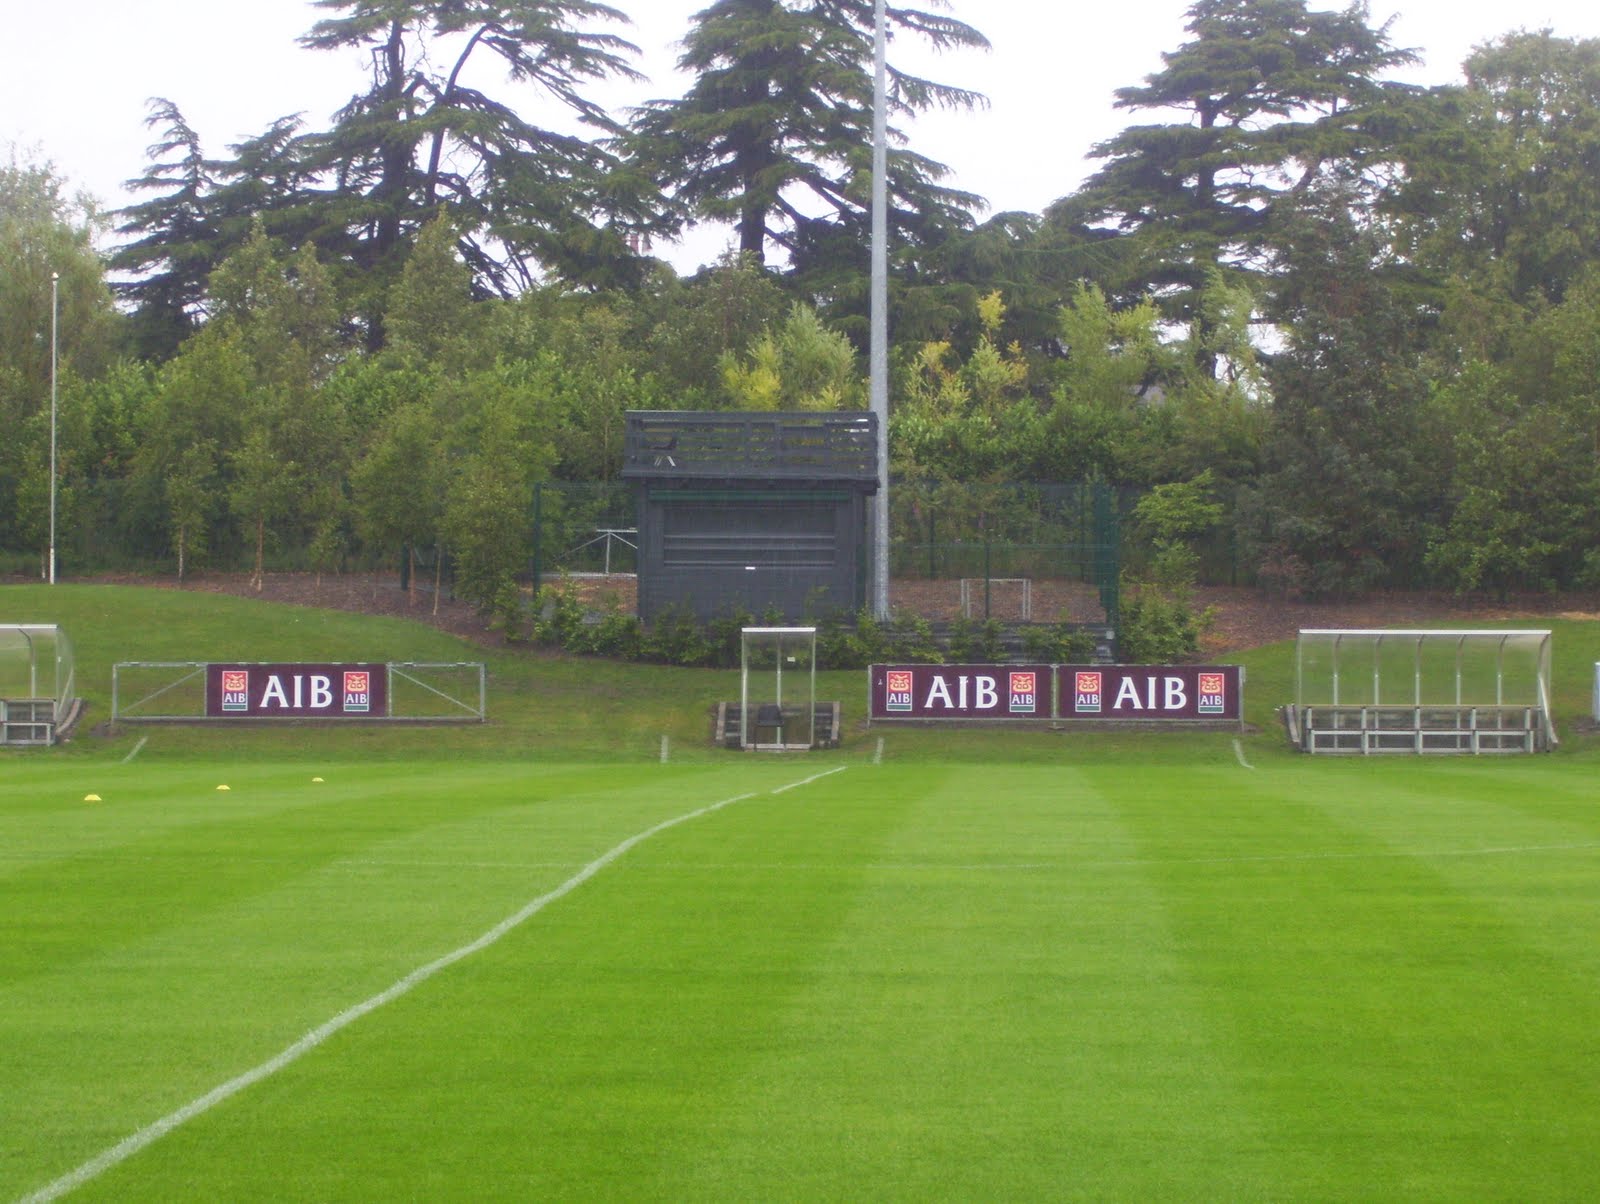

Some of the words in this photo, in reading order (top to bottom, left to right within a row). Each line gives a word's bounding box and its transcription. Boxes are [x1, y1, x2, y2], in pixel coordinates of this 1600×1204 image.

[259, 675, 333, 708] AIB
[924, 675, 998, 708] AIB
[1112, 676, 1187, 710] AIB
[224, 693, 246, 703] AIB
[346, 693, 367, 704] AIB
[888, 693, 910, 703] AIB
[1011, 694, 1033, 704] AIB
[1077, 694, 1099, 704] AIB
[1200, 695, 1222, 705] AIB
